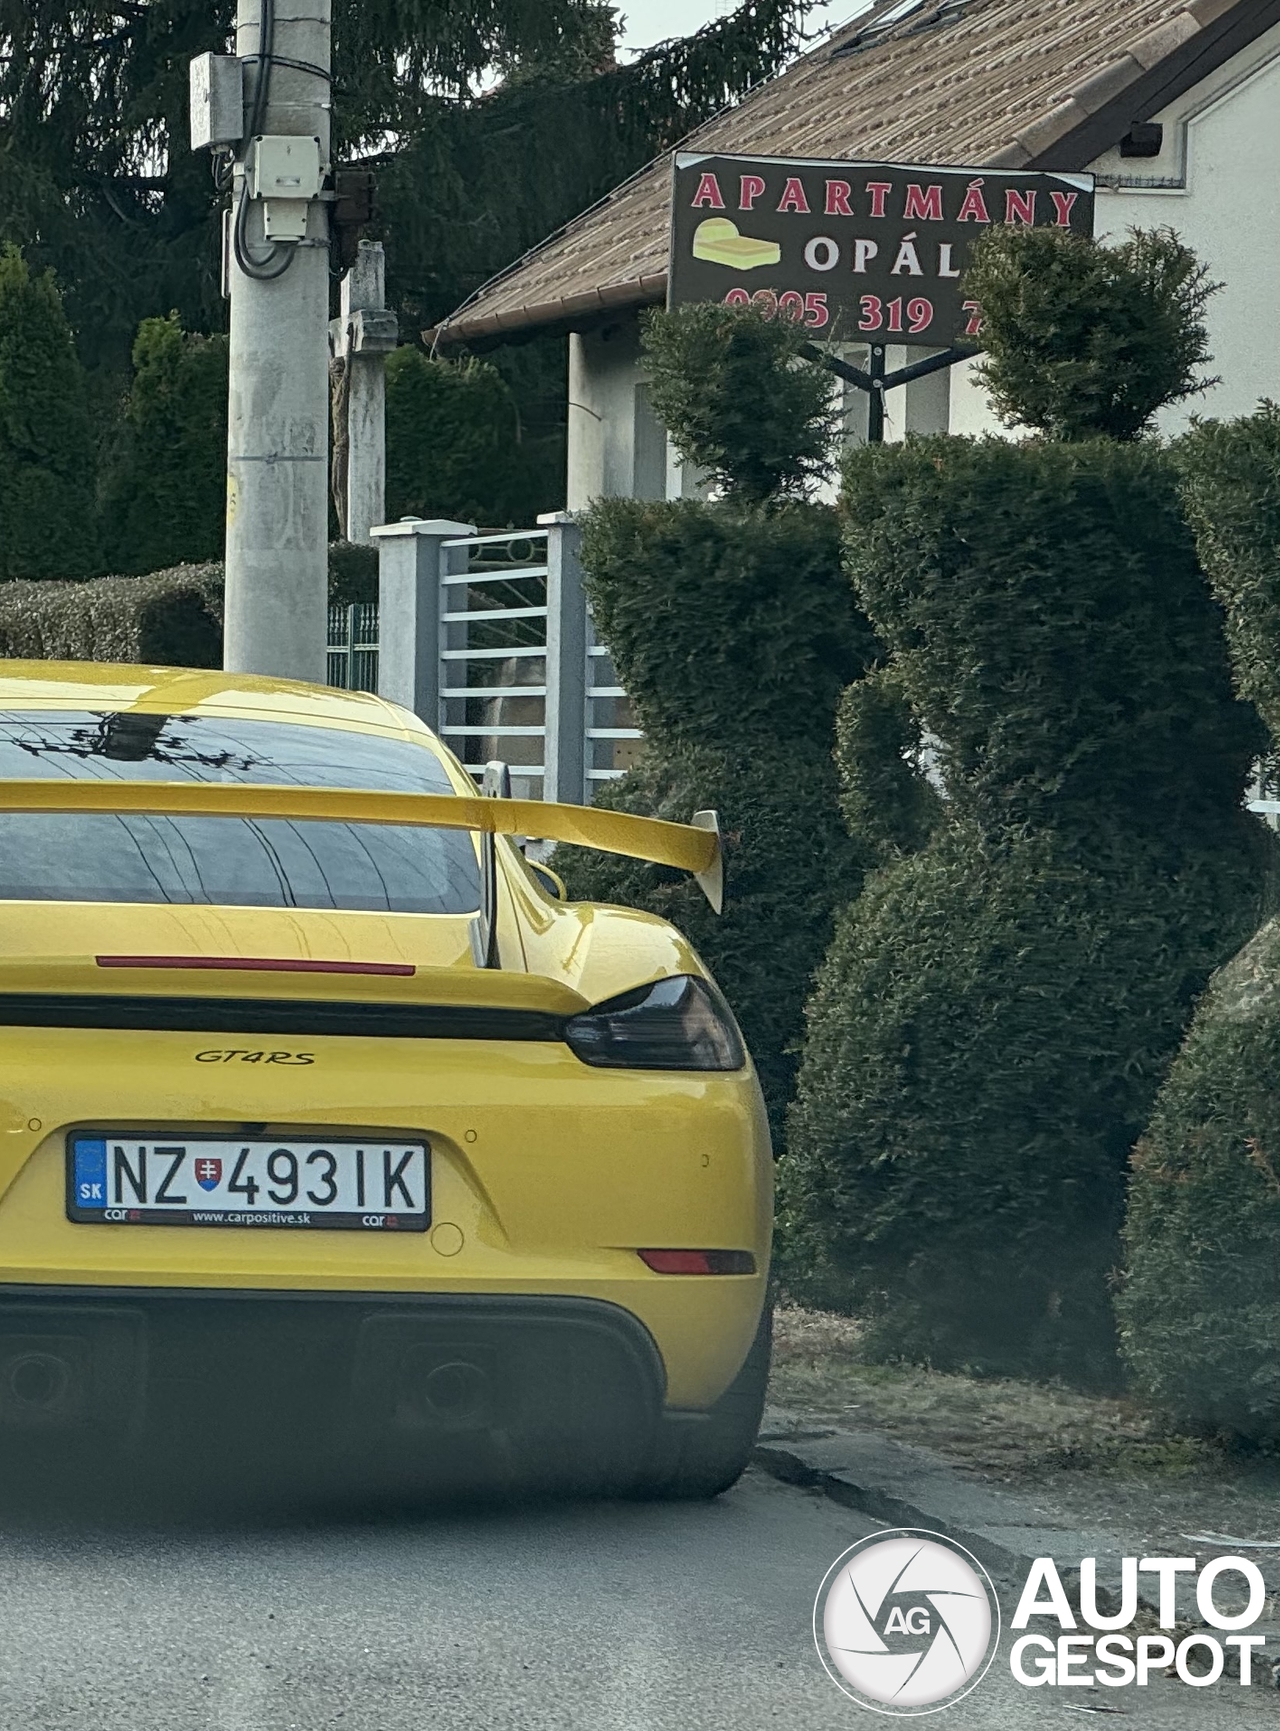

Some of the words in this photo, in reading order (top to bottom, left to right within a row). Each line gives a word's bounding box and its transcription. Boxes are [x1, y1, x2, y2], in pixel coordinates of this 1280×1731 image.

[691, 171, 1078, 227] APARTMÁNY
[803, 232, 961, 278] OPÁL
[858, 294, 933, 334] 319
[194, 1049, 317, 1066] GT4RS
[80, 1183, 102, 1199] SK
[114, 1146, 187, 1204] NZ
[228, 1148, 415, 1208] 493IK
[193, 1211, 311, 1226] www.carpositive.sk
